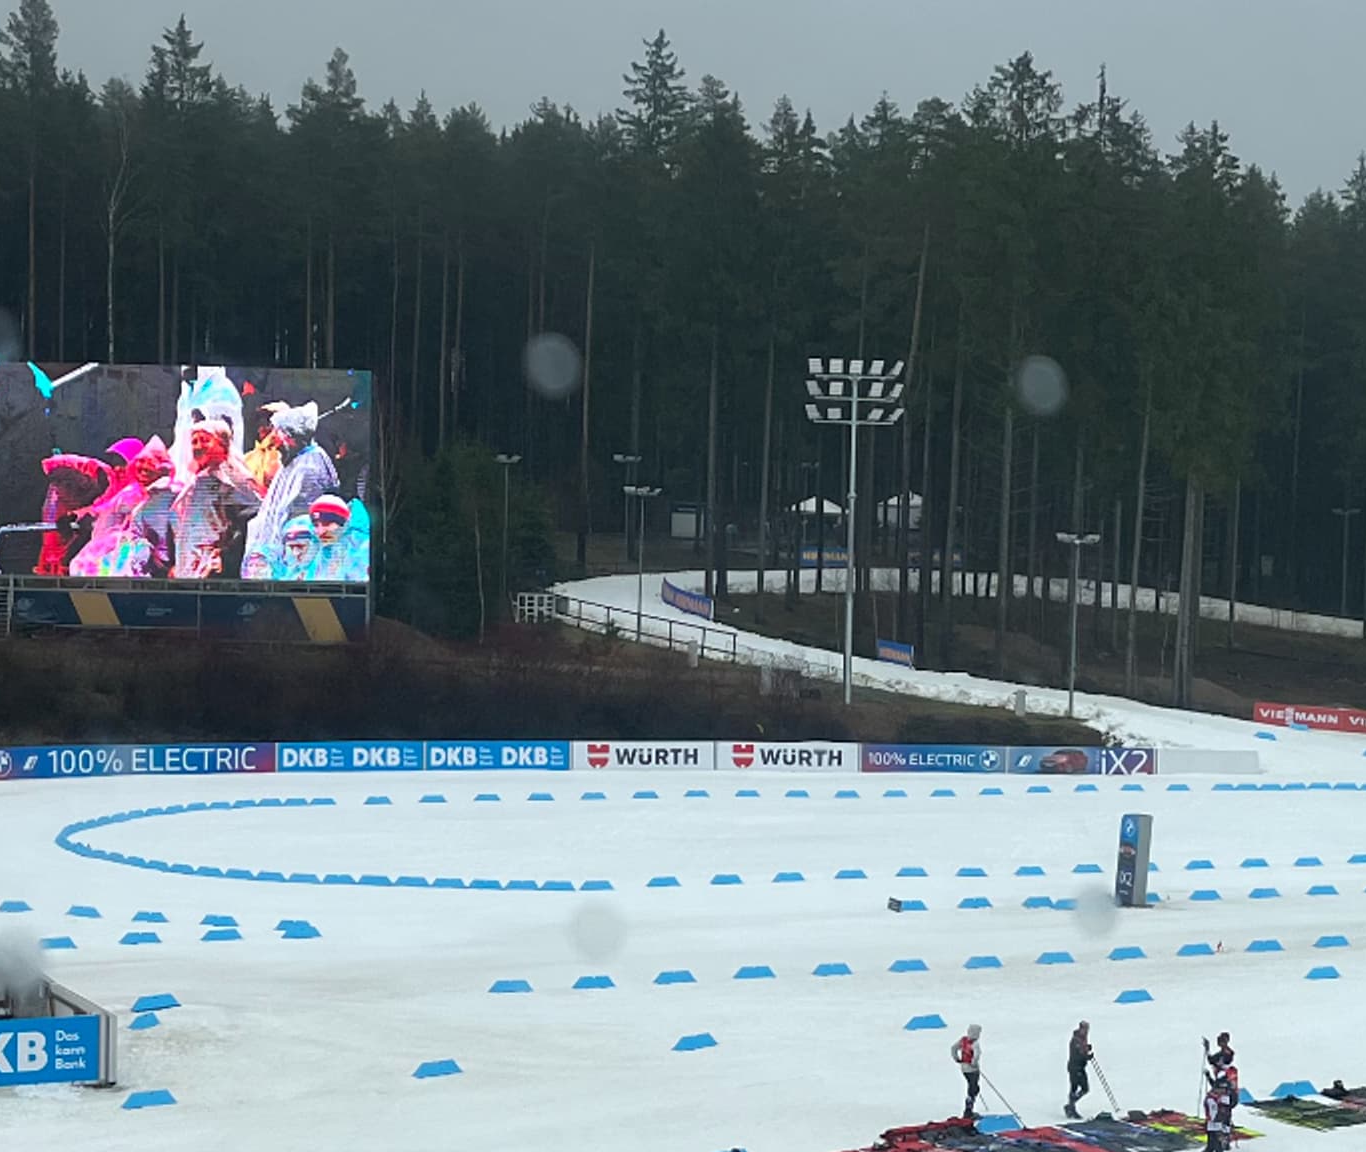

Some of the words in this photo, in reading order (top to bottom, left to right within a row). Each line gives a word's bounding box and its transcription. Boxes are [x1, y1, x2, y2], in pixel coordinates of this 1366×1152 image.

[1259, 707, 1338, 726] VIESSMANN
[47, 749, 123, 774] 100%
[132, 747, 257, 772] ELECTRIC
[282, 747, 328, 767] DKB
[352, 747, 400, 767] DKB
[430, 746, 476, 766] DKB
[501, 746, 547, 766] DKB
[615, 748, 698, 765] WÜRTH
[761, 748, 843, 767] WÜRTH
[868, 751, 906, 765] 100%
[909, 753, 974, 767] ELECTRIC
[1101, 750, 1147, 775] iX2
[55, 1030, 80, 1041] Das
[55, 1044, 86, 1056] kann
[55, 1057, 86, 1070] Bank
